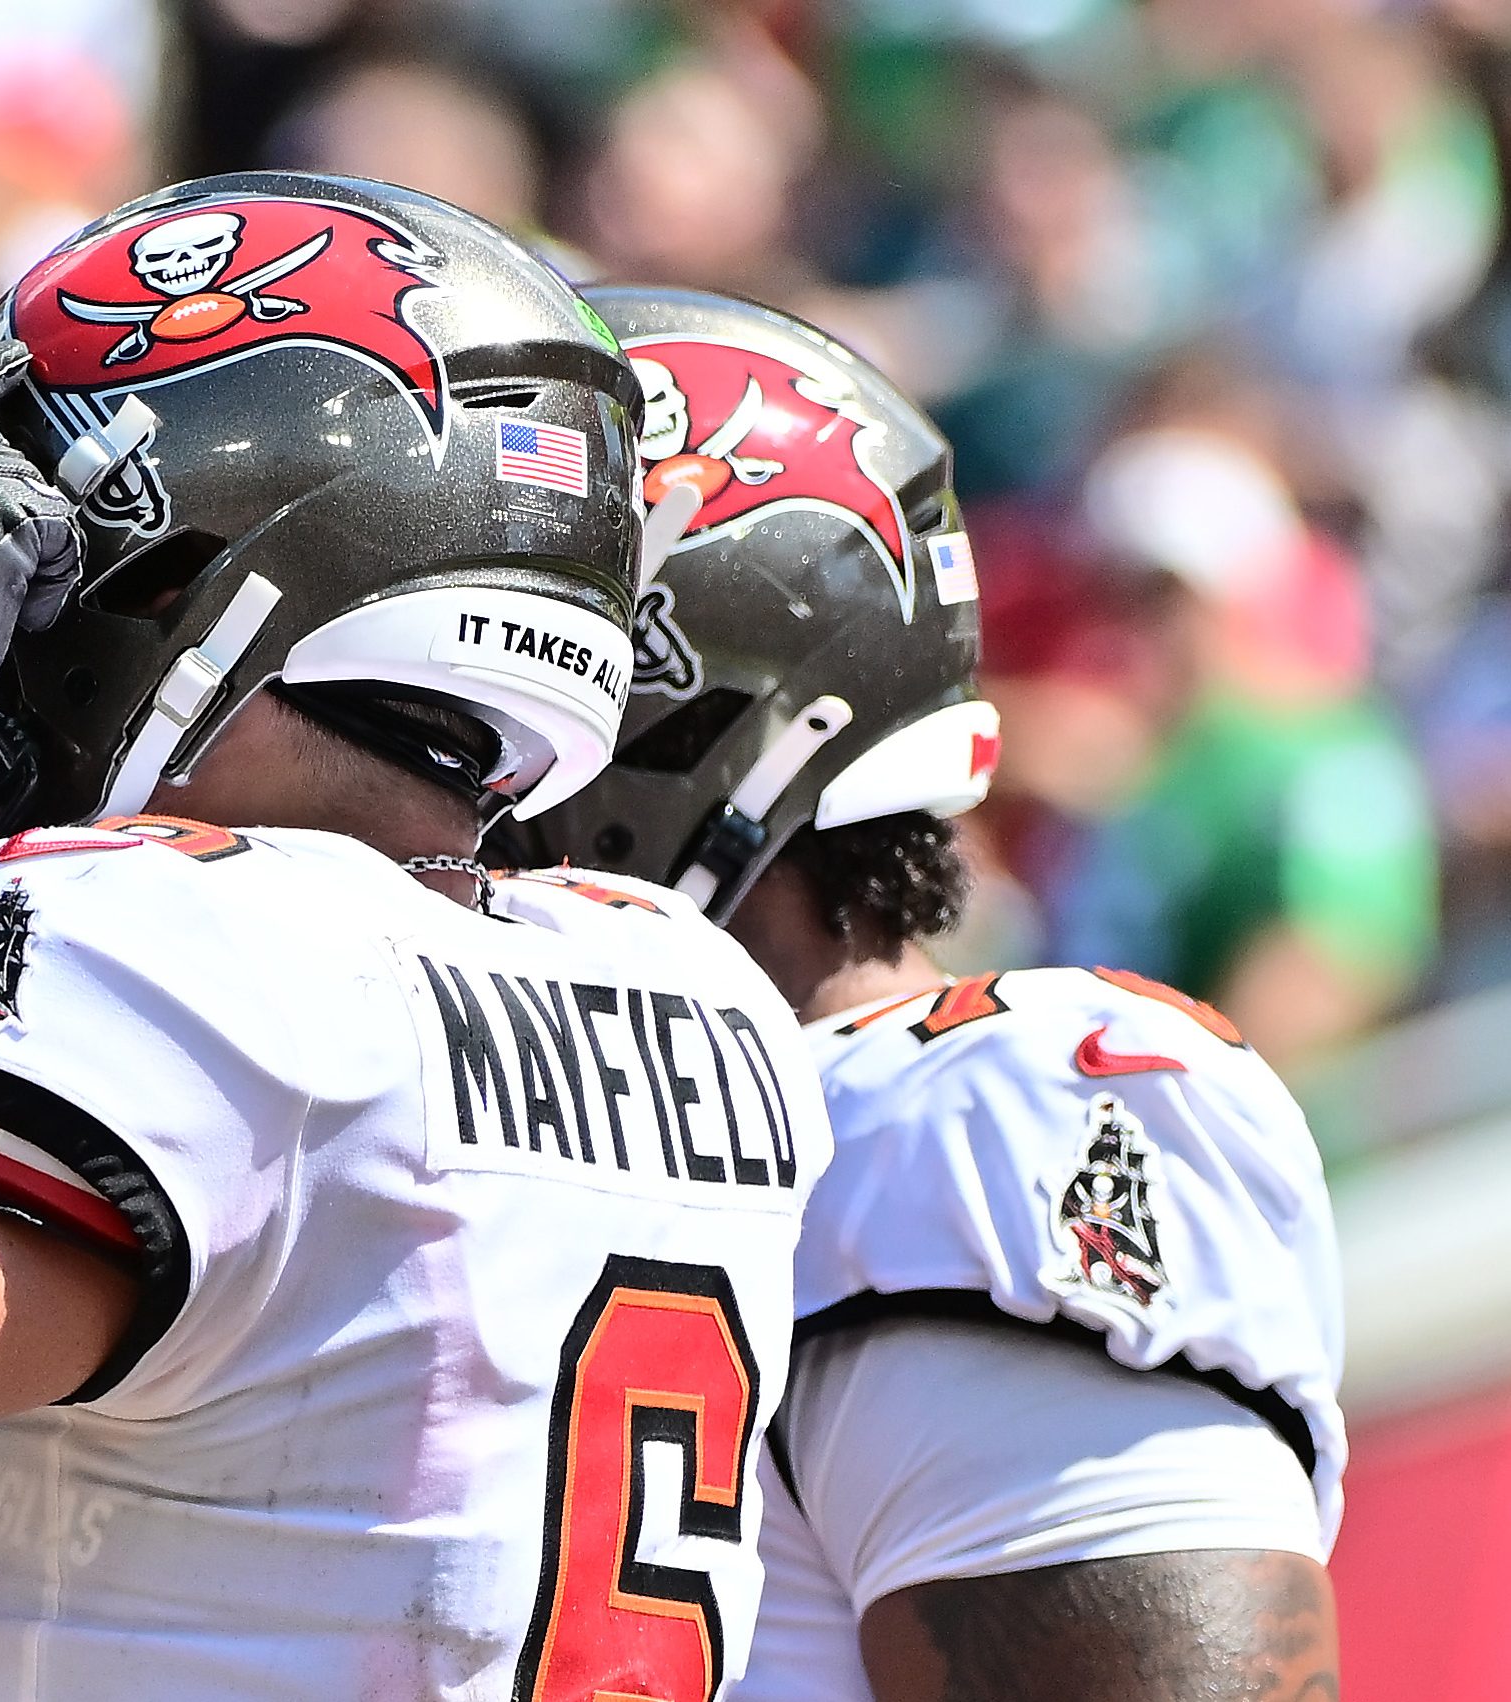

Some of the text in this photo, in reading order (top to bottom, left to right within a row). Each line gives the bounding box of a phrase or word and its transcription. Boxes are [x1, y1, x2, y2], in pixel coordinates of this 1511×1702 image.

[458, 613, 490, 645] IT
[501, 620, 592, 677] TAKES
[591, 657, 622, 701] ALL
[417, 954, 797, 1189] MAYFIELD
